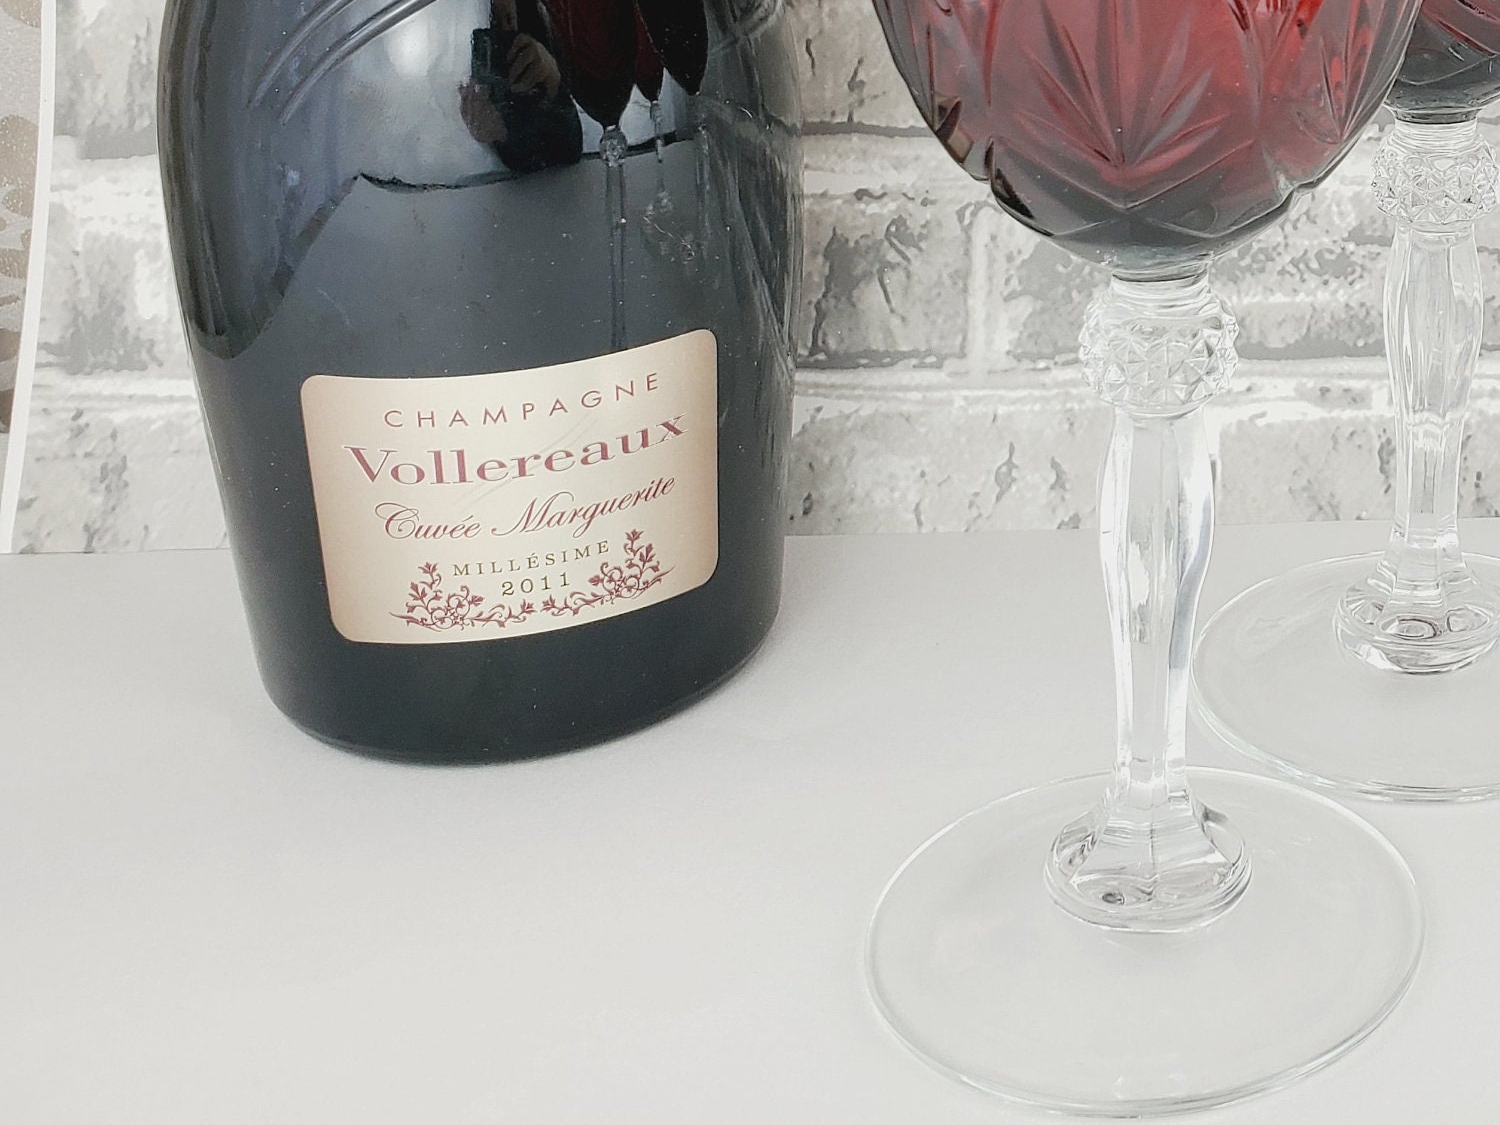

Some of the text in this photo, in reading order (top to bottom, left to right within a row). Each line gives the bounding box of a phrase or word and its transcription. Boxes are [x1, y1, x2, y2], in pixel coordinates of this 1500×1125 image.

[384, 372, 660, 428] CHAMPAGNE
[344, 414, 688, 485] Vollereaux
[374, 476, 676, 540] Cuvée Marguerite
[453, 540, 610, 577] MILLÉSIME
[501, 572, 571, 597] 2011
